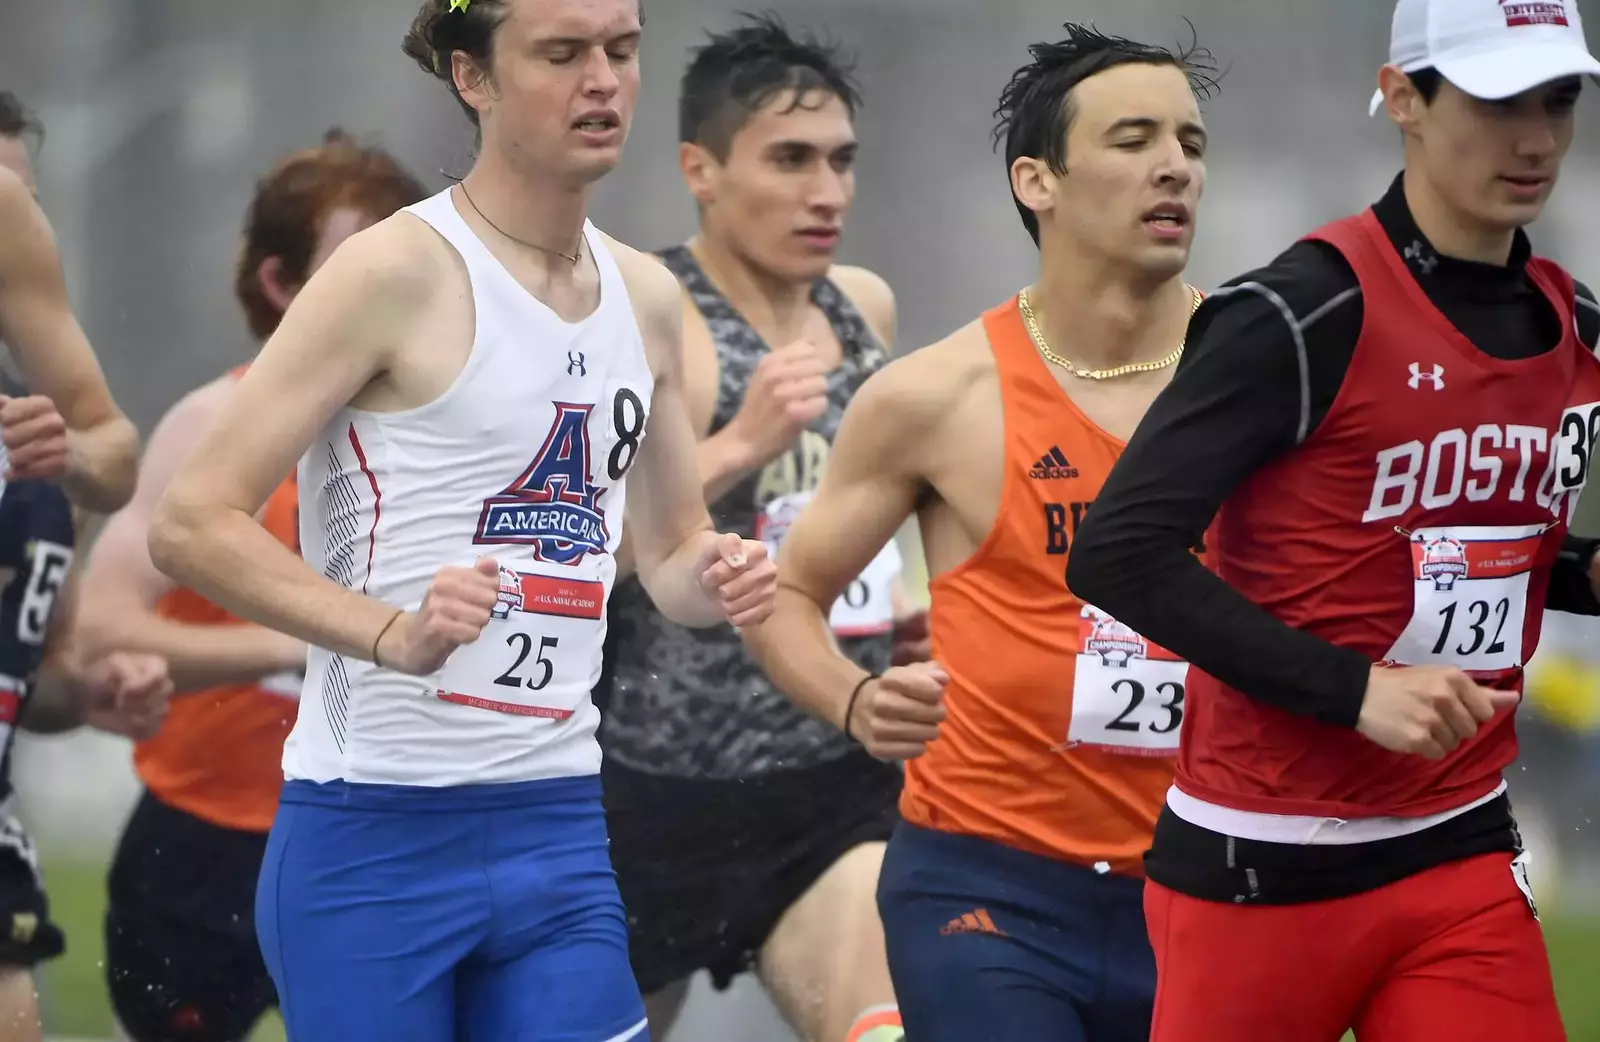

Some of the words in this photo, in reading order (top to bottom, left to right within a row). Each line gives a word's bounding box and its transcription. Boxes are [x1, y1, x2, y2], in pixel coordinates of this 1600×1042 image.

[608, 388, 646, 481] 8
[1029, 468, 1080, 480] adidas
[494, 510, 600, 541] AMERICAN
[1432, 598, 1509, 655] 132
[494, 633, 559, 691] 25
[1105, 679, 1185, 733] 23
